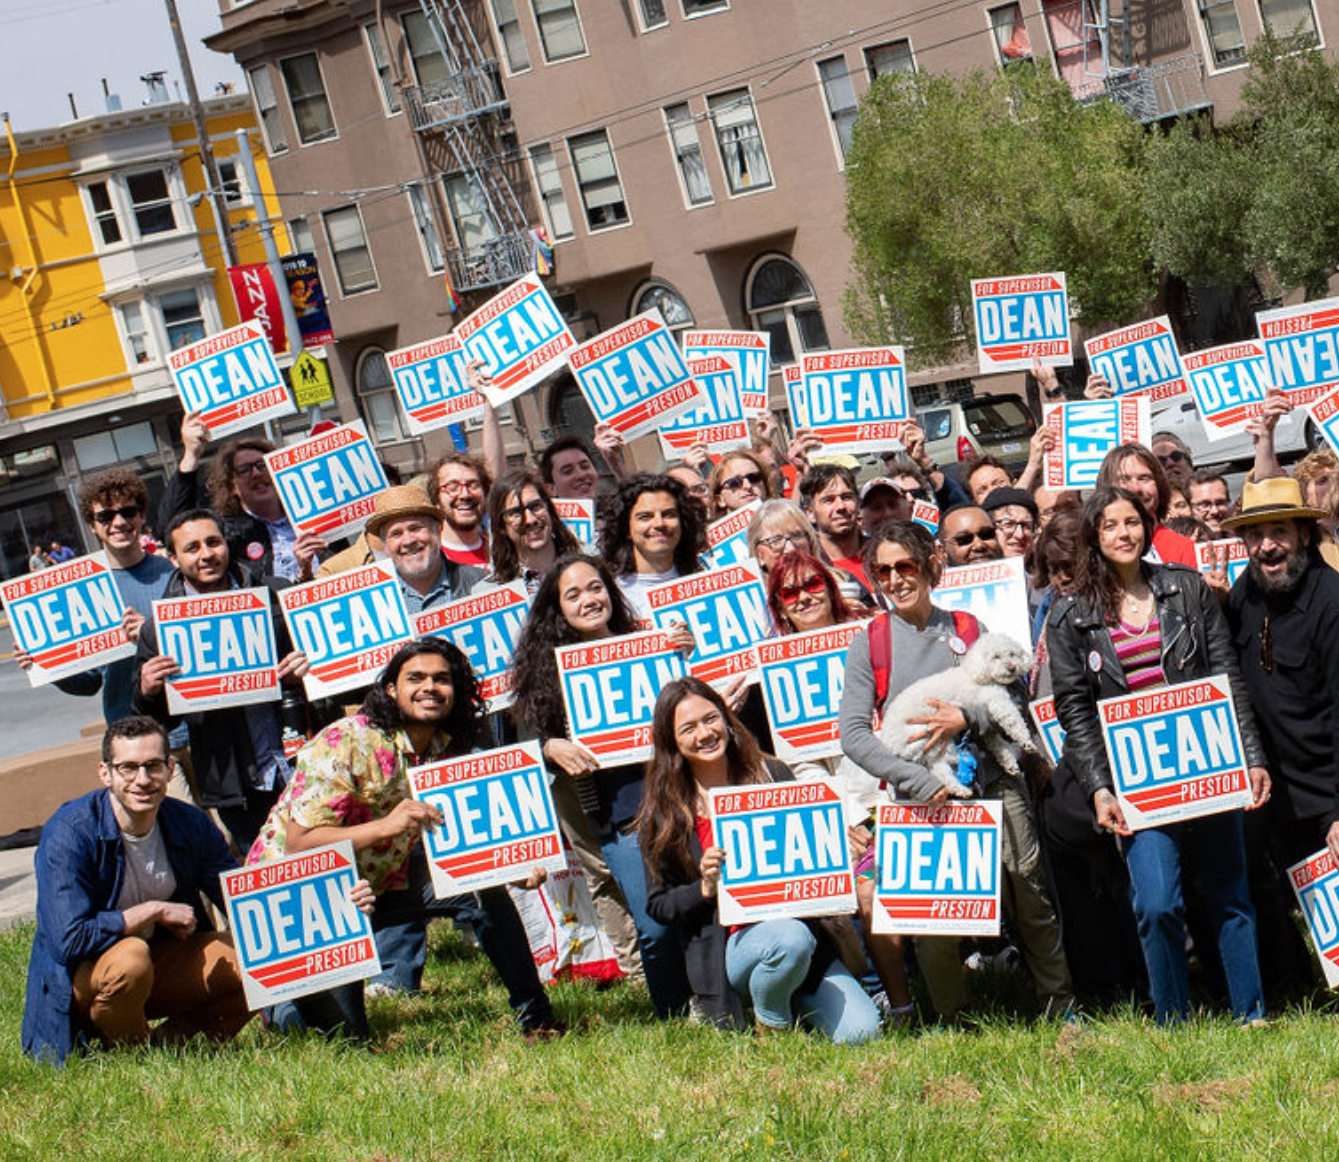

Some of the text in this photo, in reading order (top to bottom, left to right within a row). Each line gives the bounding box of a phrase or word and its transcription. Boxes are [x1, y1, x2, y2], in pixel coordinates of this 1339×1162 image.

[977, 279, 1052, 294] FOR SUPERVISOR
[469, 294, 553, 378] DEAN
[981, 295, 1064, 342] DEAN
[1090, 321, 1158, 352] FOR SUPERVISOR
[1267, 314, 1312, 336] PRESTON
[173, 329, 249, 369] FOR SUPERVISOR
[526, 334, 565, 372] PRESTON
[574, 320, 650, 367] FOR SUPERVISOR
[806, 352, 891, 370] FOR SUPERVISOR
[1022, 343, 1065, 357] PRESTON
[180, 346, 276, 412] DEAN
[582, 335, 684, 415] DEAN
[788, 368, 799, 380] FO
[1096, 338, 1178, 395] DEAN
[237, 390, 282, 417] PRESTON
[646, 386, 692, 418] PRESTON
[809, 371, 903, 422] DEAN
[1316, 400, 1338, 420] FOR
[697, 425, 742, 442] PRESTON
[857, 423, 896, 440] PRESTO
[272, 430, 352, 471] FOR SUPERVISOR
[280, 446, 381, 522] DEAN
[340, 498, 374, 523] PREST
[6, 561, 94, 600] FOR SUPERVISOR
[287, 568, 379, 609] FOR SUPERVISOR
[652, 569, 744, 606] FOR SUPERVISOR
[14, 577, 120, 650] DEAN
[160, 595, 254, 618] FOR SUPERVISOR
[293, 587, 408, 662] DEAN
[420, 590, 511, 631] FOR SUPERVISOR
[76, 630, 126, 658] PRESTON
[164, 612, 273, 675] DEAN
[566, 636, 667, 668] FOR SUPERVISOR
[762, 645, 783, 660] FOR
[727, 652, 757, 673] PRES
[220, 672, 272, 694] PRESTON
[767, 657, 845, 722] DEA
[1039, 703, 1055, 720] FO
[1108, 685, 1212, 721] FOR SUPERVISOR
[1114, 706, 1236, 787] DEAN
[418, 751, 523, 787] FOR SUPERVISOR
[718, 786, 826, 812] FOR SUPERVISOR
[1180, 774, 1239, 801] PRESTON
[424, 773, 550, 853] DEAN
[882, 807, 984, 823] FOR SUPERVISOR
[492, 836, 554, 868] PRESTON
[721, 808, 844, 880] DEAN
[882, 832, 993, 891] DEAN
[230, 850, 336, 896] FOR SUPERVISOR
[784, 876, 846, 900] PRESTON
[238, 874, 360, 962] DEAN
[930, 901, 992, 918] PRESTON
[306, 942, 366, 975] PRESTON
